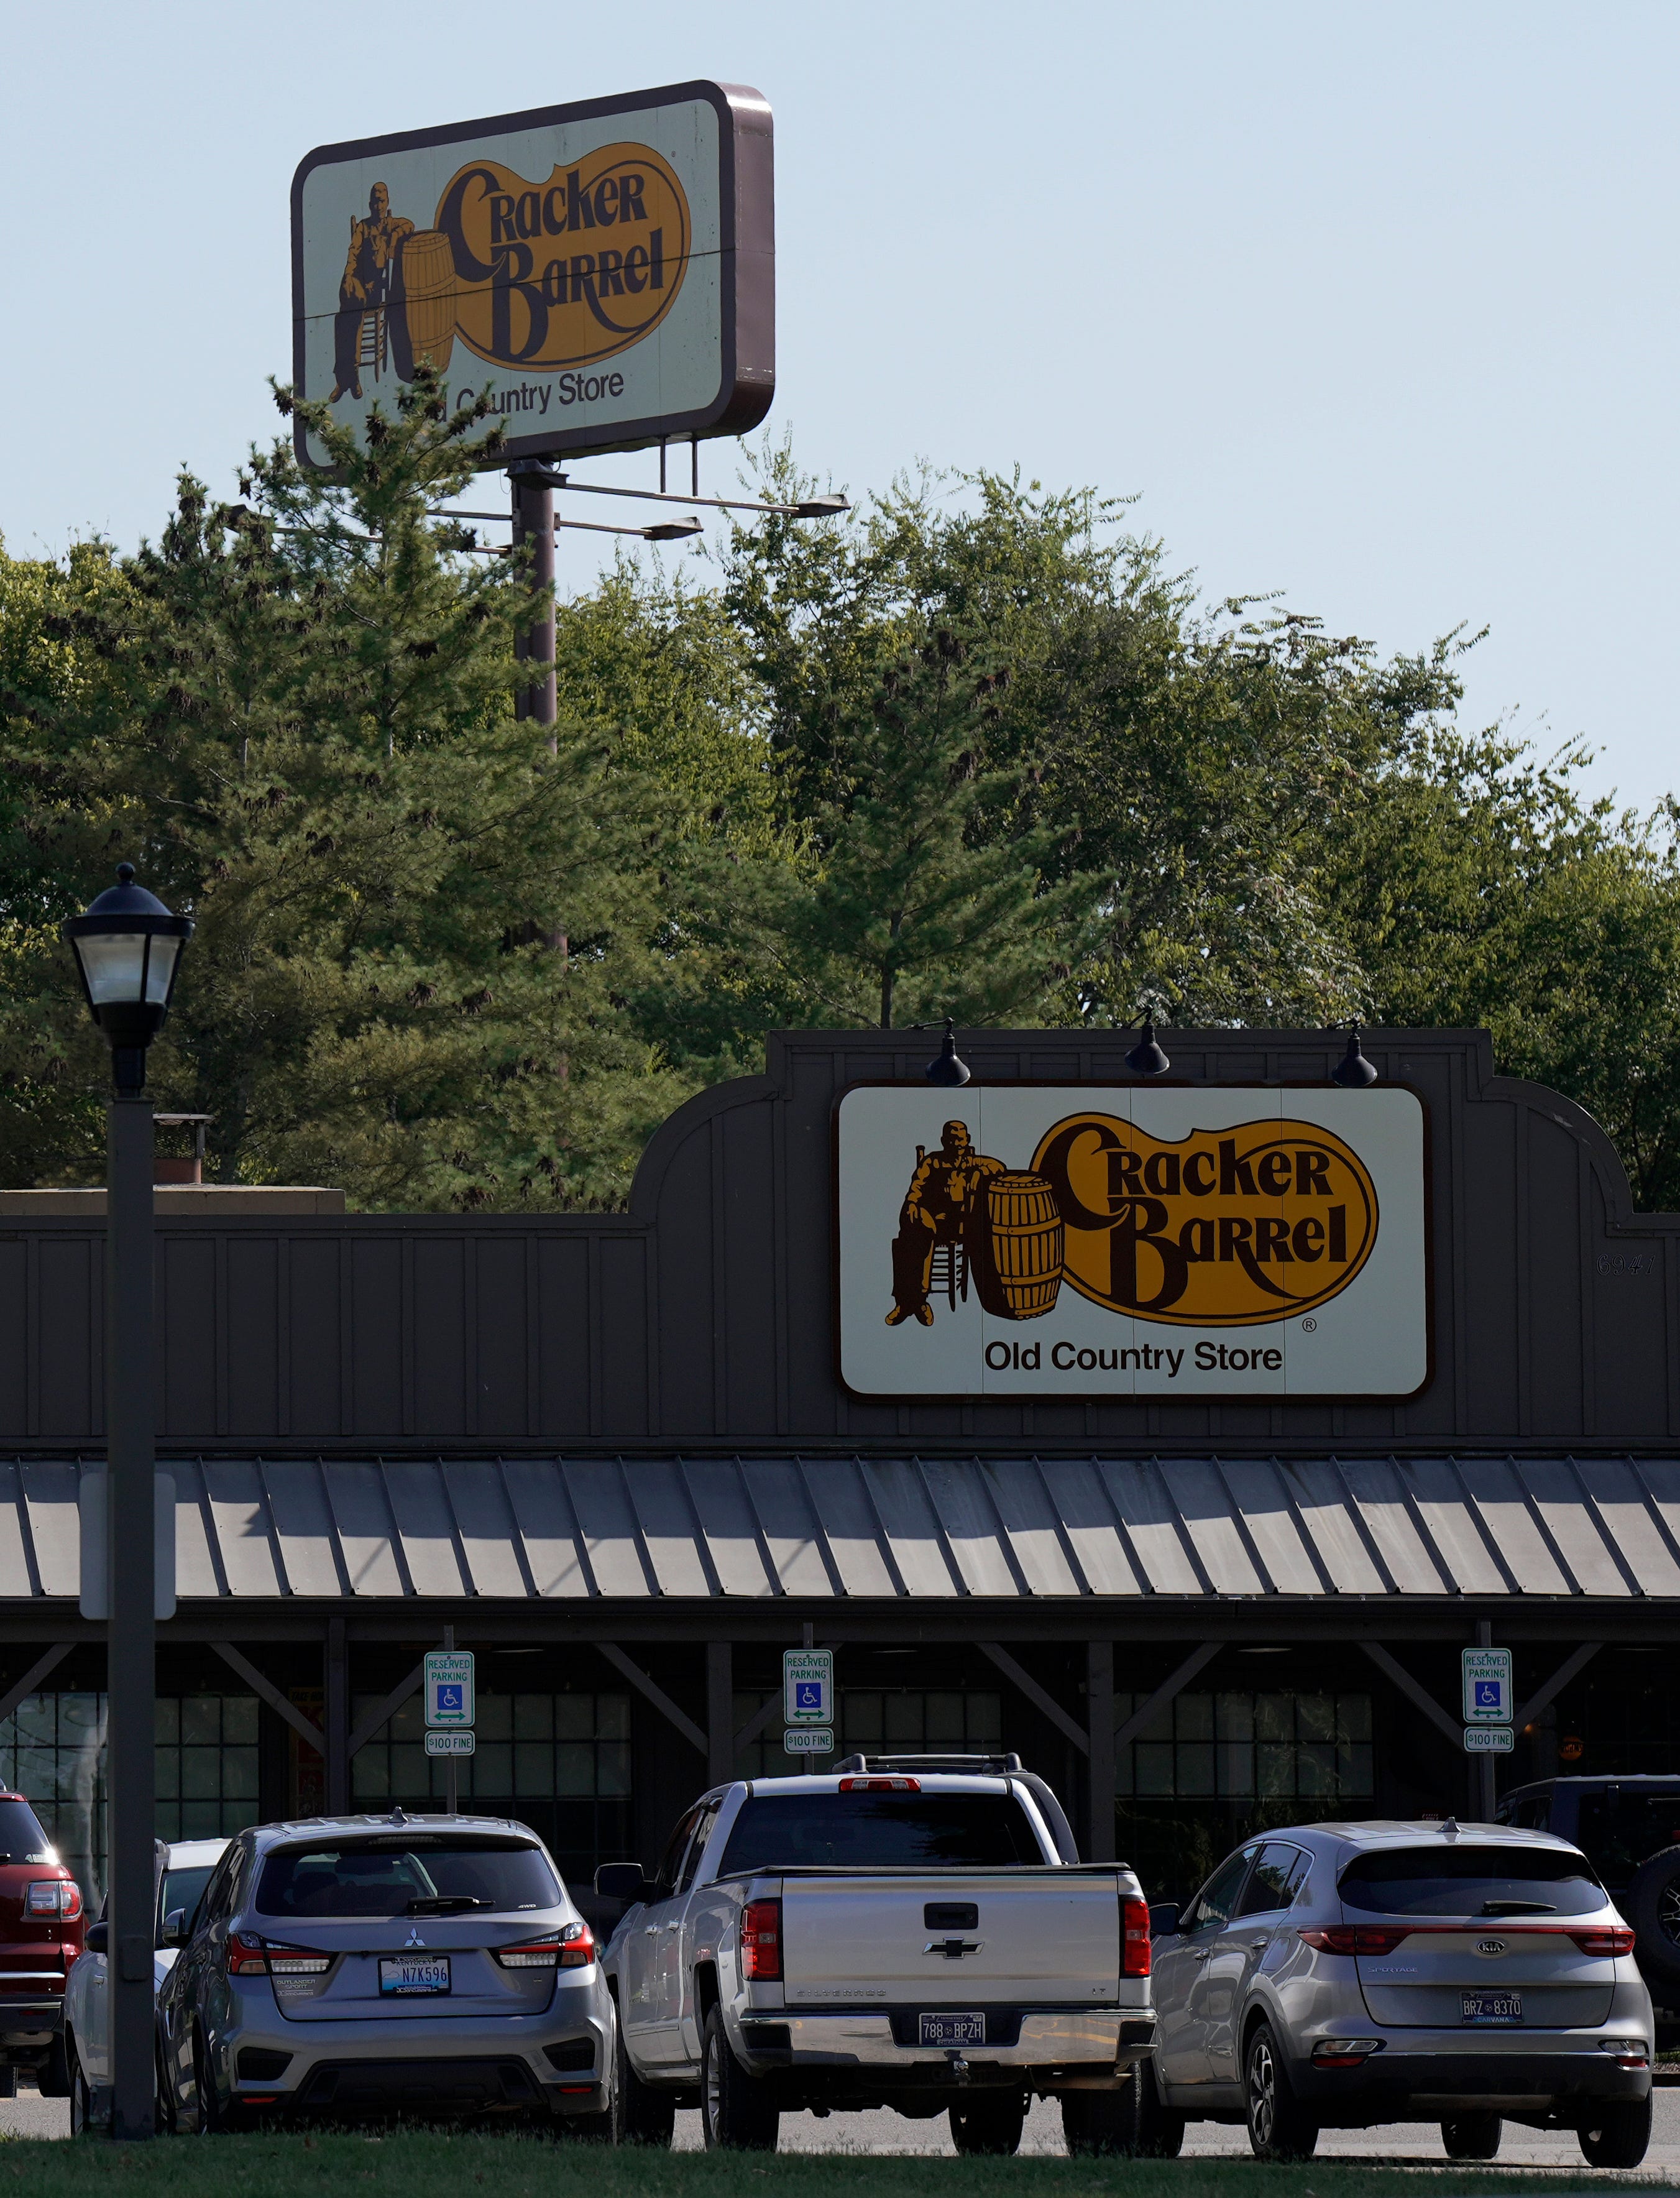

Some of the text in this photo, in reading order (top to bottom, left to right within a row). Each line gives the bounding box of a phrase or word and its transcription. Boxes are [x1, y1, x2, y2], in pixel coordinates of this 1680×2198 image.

[456, 382, 551, 415] Cuntry
[559, 373, 623, 405] Store
[1597, 1254, 1656, 1276] 6941
[985, 1341, 1282, 1377] Old Country Store
[428, 1660, 470, 1669] RESERVED
[787, 1657, 829, 1667] RESERVED
[1466, 1656, 1507, 1666] RESERVED
[431, 1672, 467, 1681] PARKING
[791, 1670, 826, 1679] PARKING
[1469, 1669, 1505, 1678] PARKING
[429, 1737, 471, 1749] $100 FINE
[788, 1736, 830, 1746] $100 FINE
[1468, 1734, 1510, 1745] $100 FINE
[1482, 1943, 1500, 1951] KIA
[403, 1967, 447, 1982] N7K596
[797, 1989, 886, 1997] SILVERADO
[1463, 2000, 1521, 2015] BRZ 8370
[923, 2023, 981, 2038] 788 BPZH
